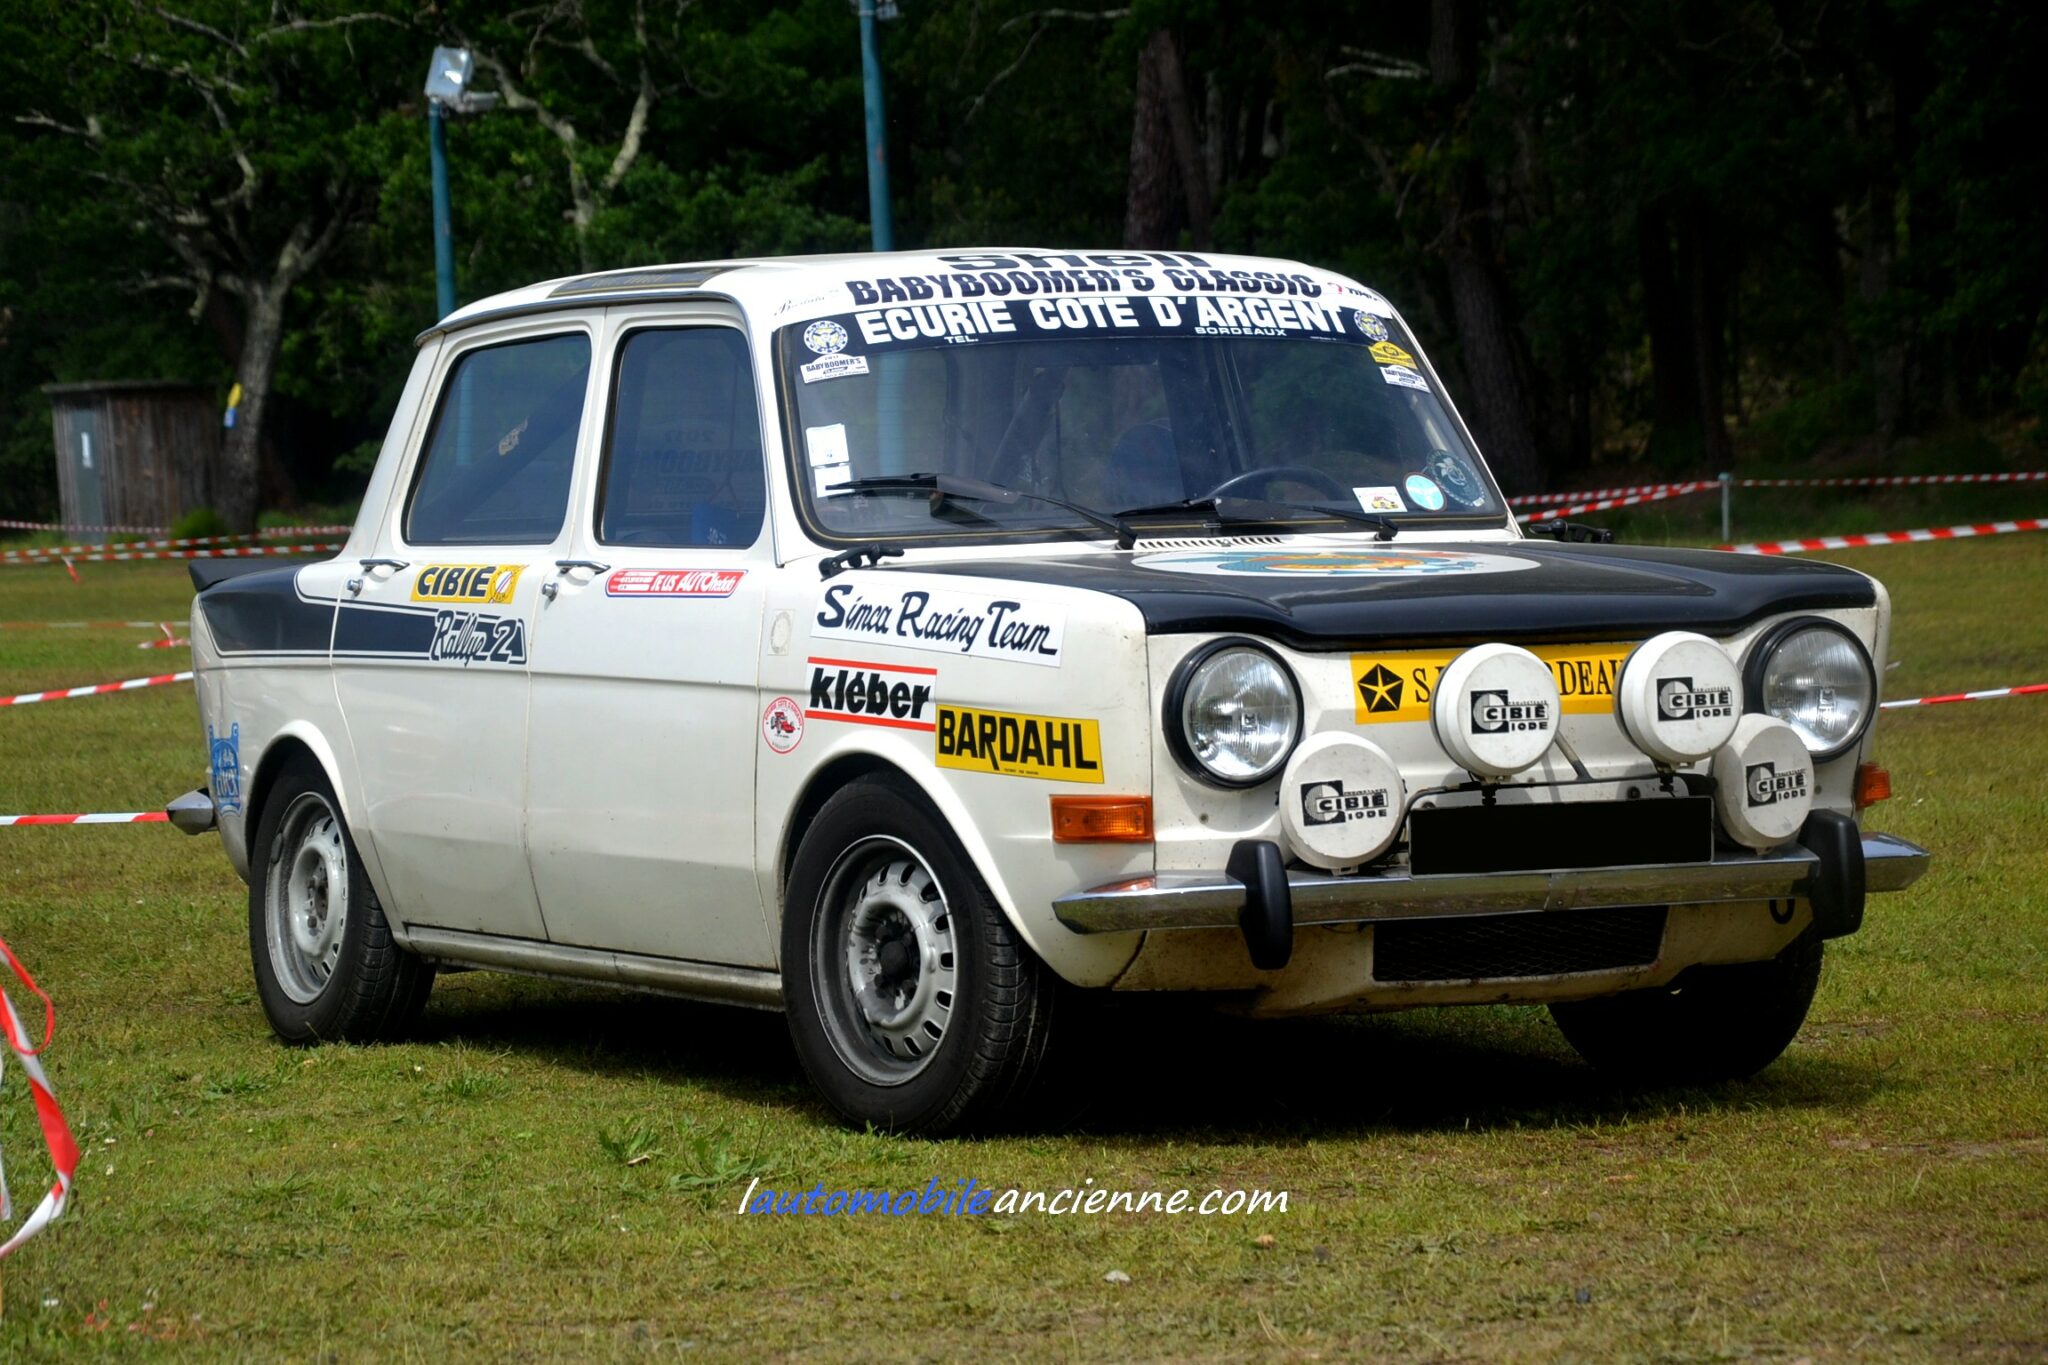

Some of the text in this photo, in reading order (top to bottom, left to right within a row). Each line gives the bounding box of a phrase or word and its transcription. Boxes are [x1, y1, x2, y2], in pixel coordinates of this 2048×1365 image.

[845, 269, 1155, 306] BABYBOOMER'S
[1162, 268, 1323, 299] CLASSIC
[855, 301, 1017, 345] ECURIE
[1028, 297, 1140, 330] COTE
[1148, 296, 1347, 334] D'ARGENT
[1194, 326, 1288, 337] BORDEAUX
[944, 335, 979, 344] TEL.
[816, 584, 1059, 656] Simca Racing Team
[431, 610, 518, 669] Rallye 2
[810, 667, 932, 719] kléber
[1696, 707, 1732, 719] IODE
[1511, 721, 1548, 732] IODE
[938, 709, 1098, 771] BARDAHL
[1778, 788, 1806, 801] IODE
[1348, 809, 1387, 820] IODE
